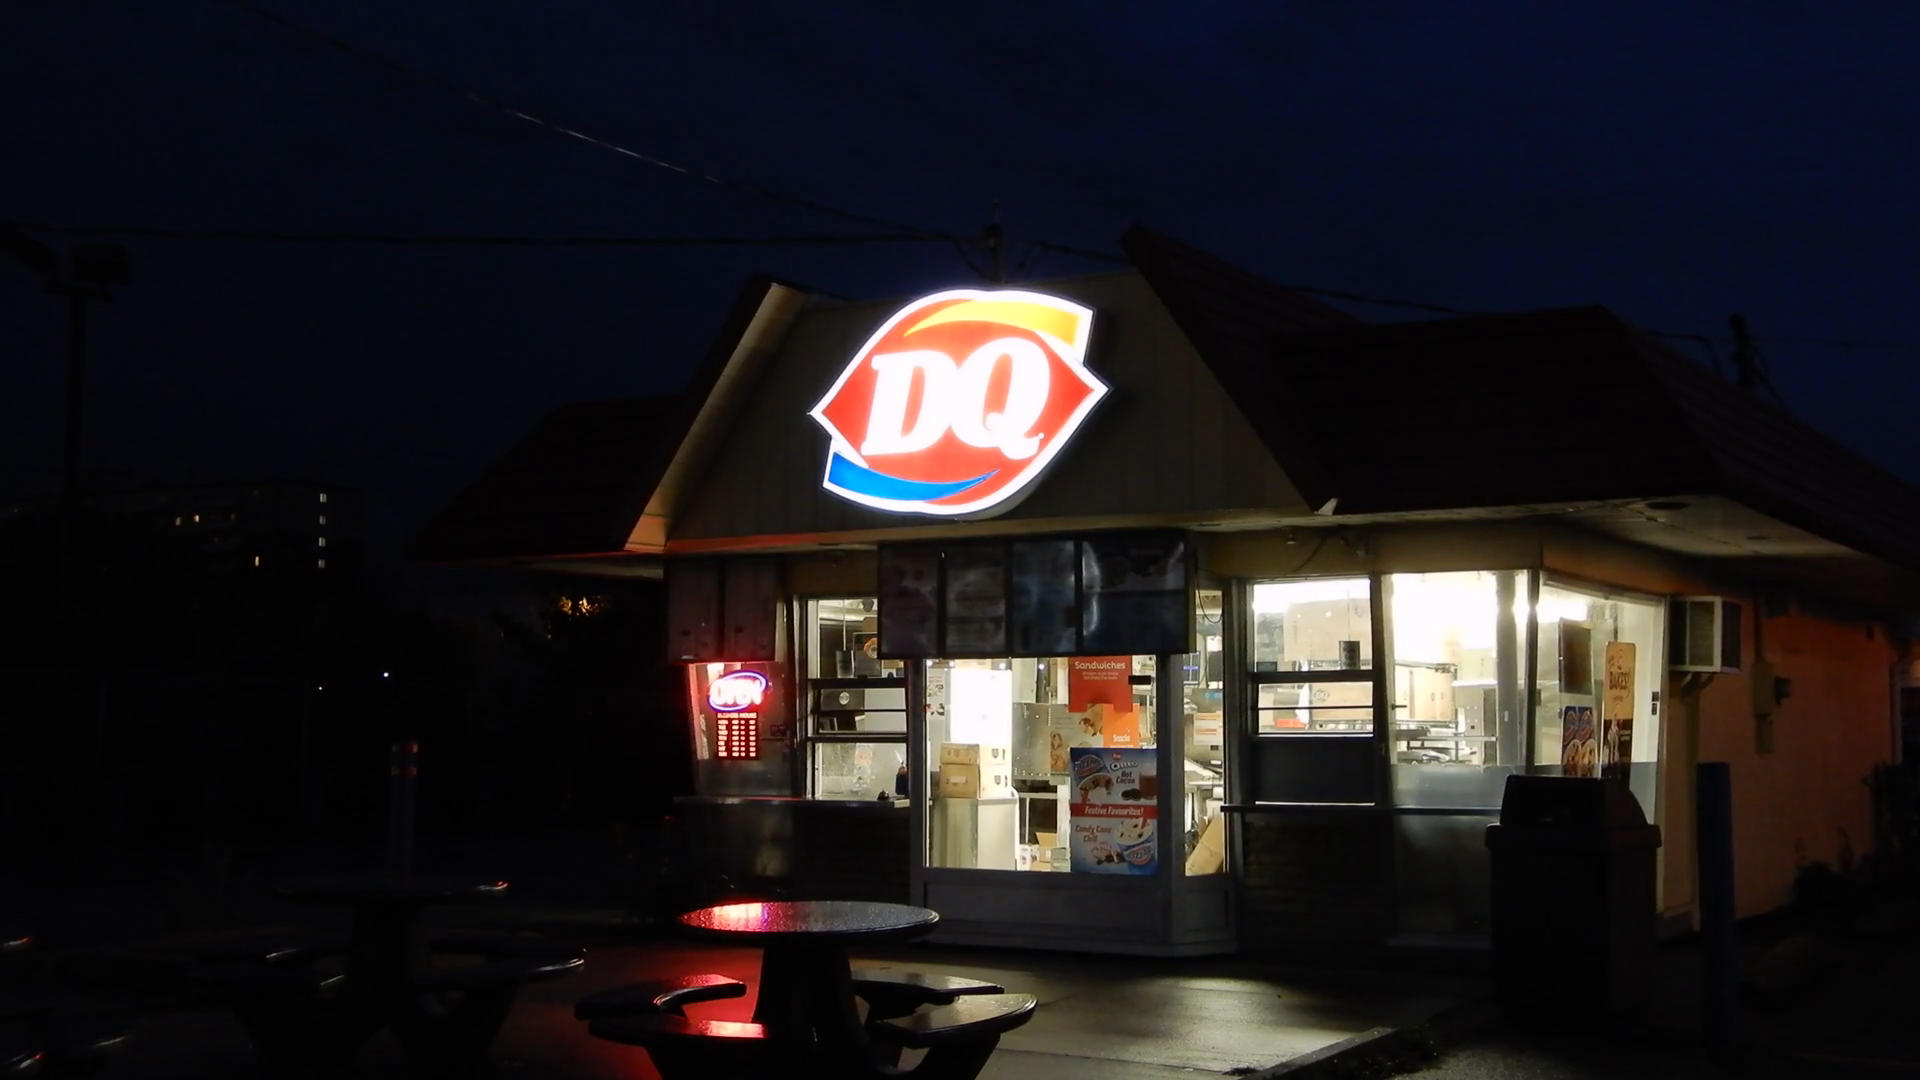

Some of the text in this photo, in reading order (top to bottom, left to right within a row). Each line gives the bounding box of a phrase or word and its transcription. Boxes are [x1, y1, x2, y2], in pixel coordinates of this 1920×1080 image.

[861, 337, 1045, 460] DQ
[1074, 660, 1126, 670] Sandwiches
[710, 678, 763, 705] OPEN
[1110, 760, 1139, 772] OREO
[1121, 770, 1133, 778] Hot
[1115, 776, 1136, 785] Cocoa
[1084, 805, 1144, 816] Festive Favourites!
[1075, 825, 1096, 836] Candy
